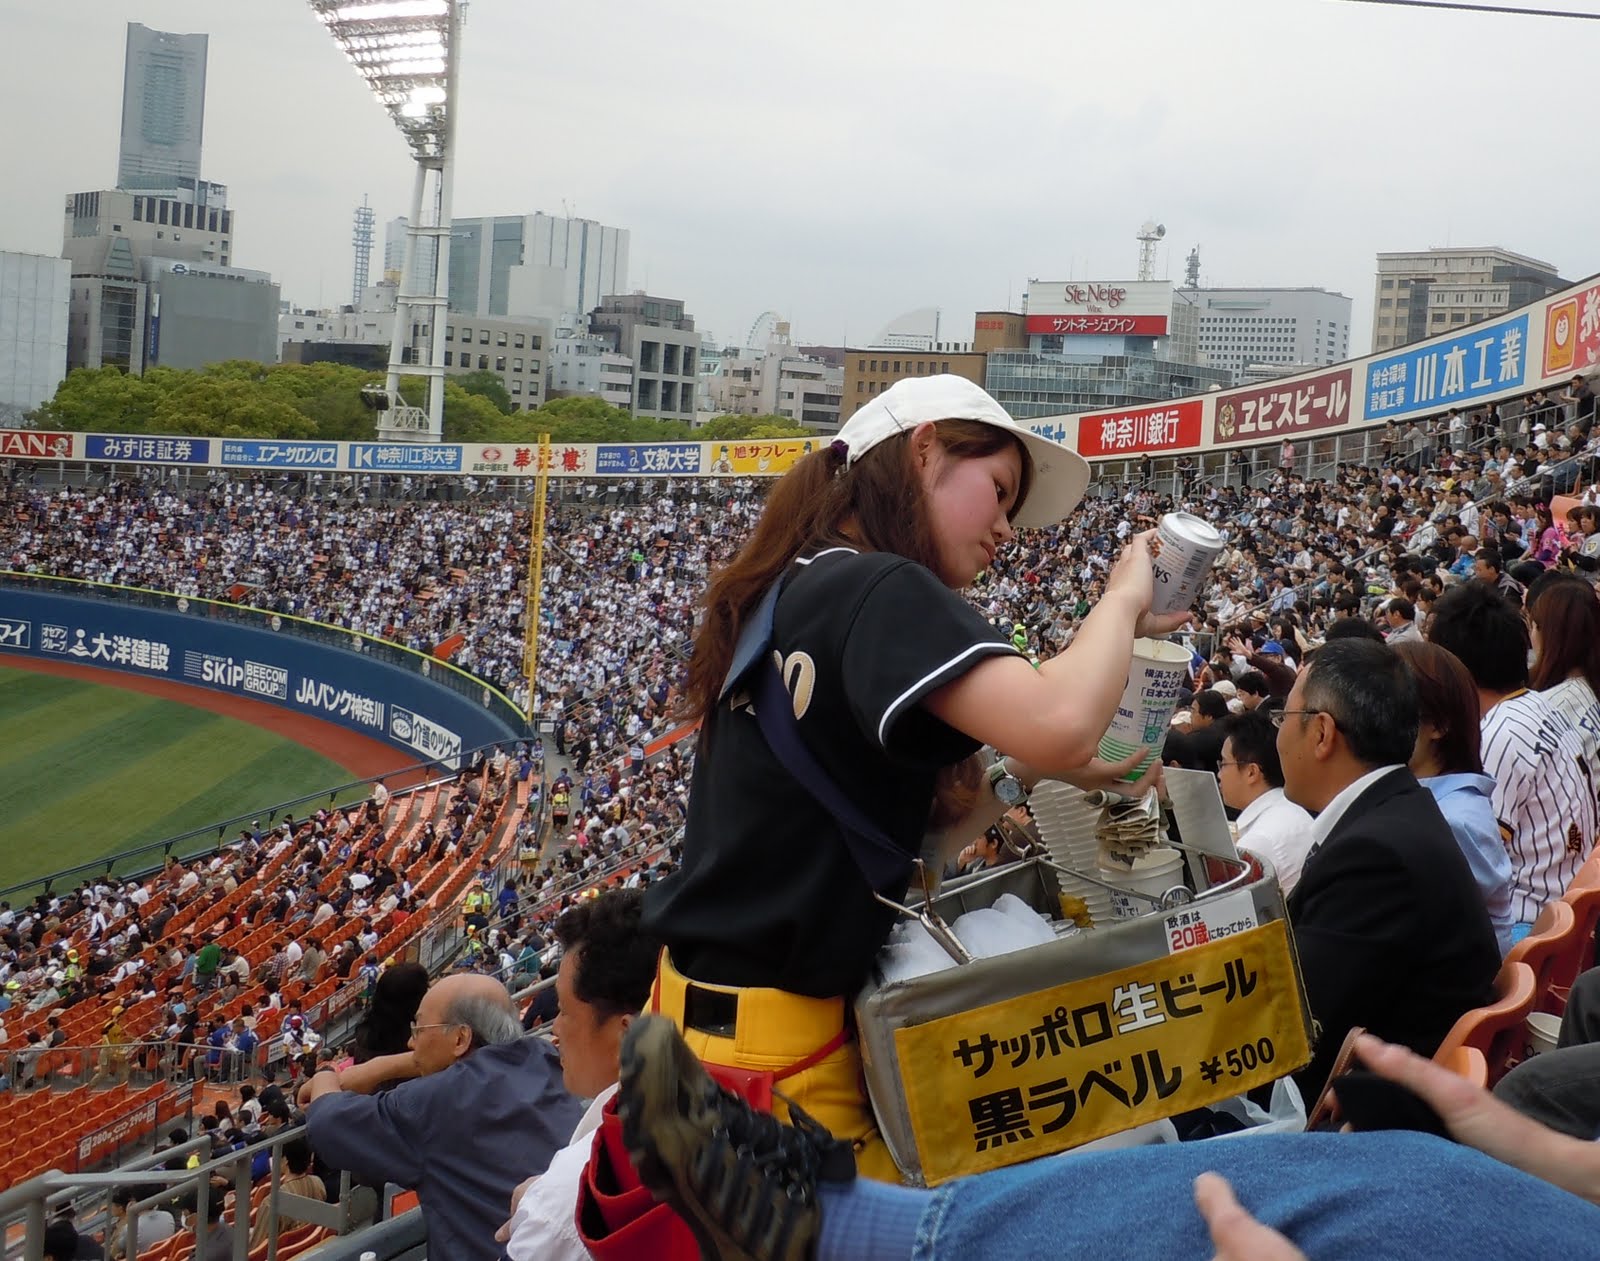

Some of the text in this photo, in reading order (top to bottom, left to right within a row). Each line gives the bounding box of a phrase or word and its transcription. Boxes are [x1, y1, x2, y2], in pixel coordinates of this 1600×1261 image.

[1053, 317, 1136, 332] サントネージュワイン
[1372, 362, 1407, 389] 総合環境
[1413, 327, 1521, 403] 川本工業
[1370, 387, 1405, 412] 設備工事
[1100, 410, 1180, 450] 神奈川銀行
[103, 438, 192, 460] みずほ証券
[256, 446, 337, 465] エアーサロンパス
[376, 447, 457, 464] 神奈川工科大学
[642, 447, 699, 471] 文教大学
[92, 632, 170, 671] 大洋建設
[245, 676, 279, 695] GROUP
[246, 663, 286, 685] BEECOM
[295, 677, 385, 731] JAバンク神奈川
[1167, 911, 1200, 929] 飲酒は
[1171, 917, 1256, 951] 20歳になってから。
[952, 958, 1257, 1078] サッポロ生ビール
[968, 1036, 1275, 1152] 黒ラベル ¥500
